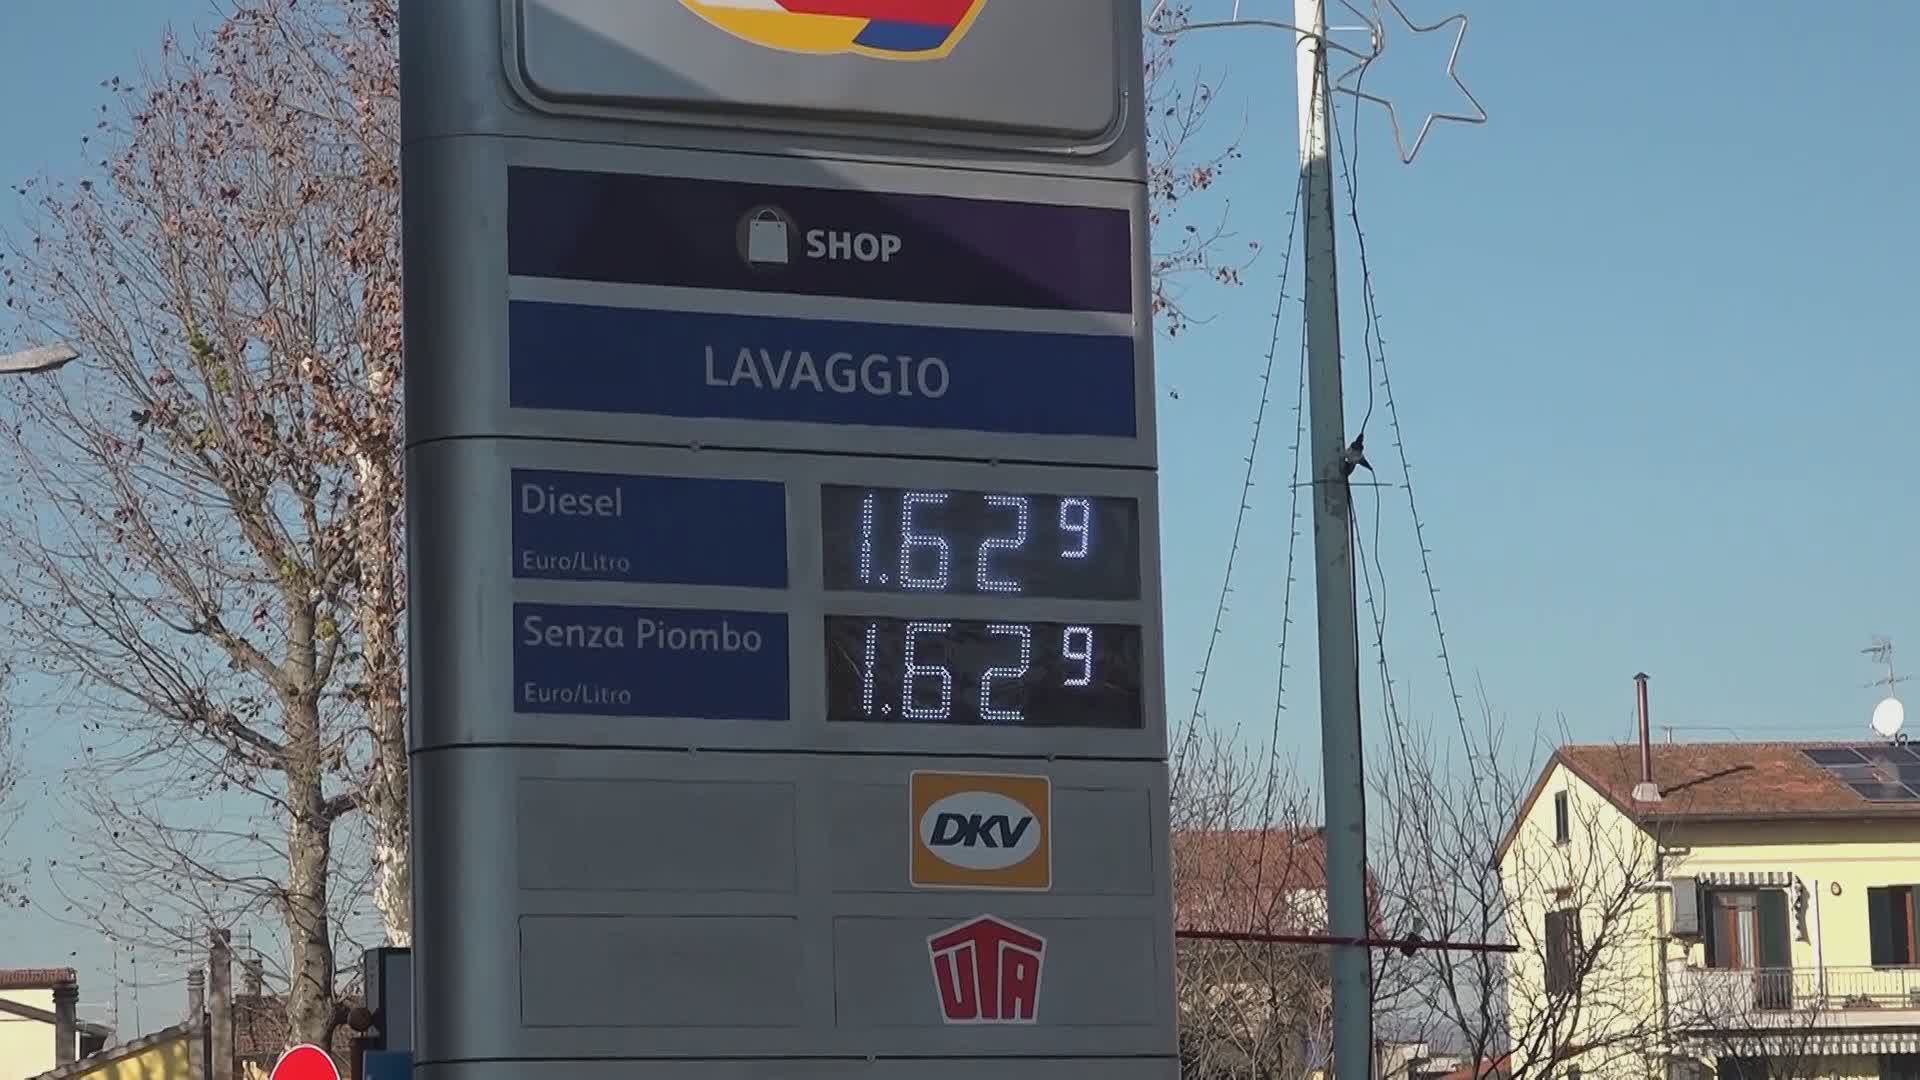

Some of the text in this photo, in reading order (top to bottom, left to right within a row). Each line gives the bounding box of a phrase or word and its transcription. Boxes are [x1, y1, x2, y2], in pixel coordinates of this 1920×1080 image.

[806, 229, 902, 263] SHOP
[705, 345, 949, 398] LAVAGGIO
[520, 484, 623, 516] Diesel
[522, 550, 631, 572] Euro/Litro
[523, 616, 763, 652] Senza Piombo
[524, 682, 632, 705] Euro/Litro
[929, 813, 1033, 849] DKV
[928, 916, 1045, 1022] UTA
